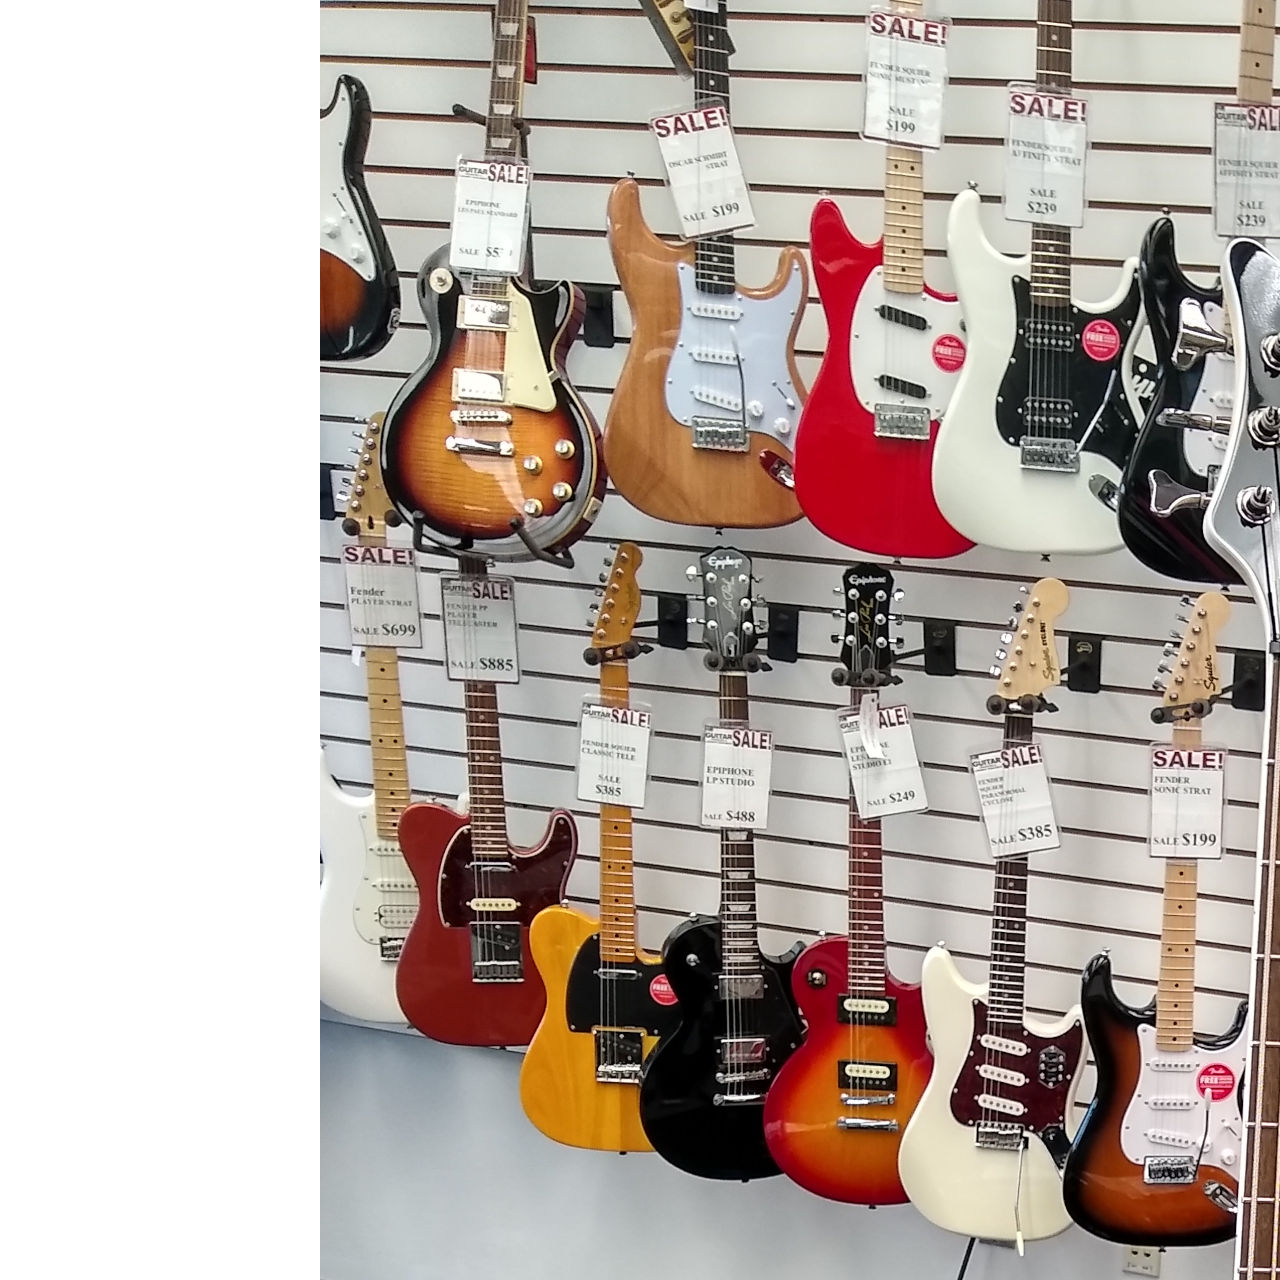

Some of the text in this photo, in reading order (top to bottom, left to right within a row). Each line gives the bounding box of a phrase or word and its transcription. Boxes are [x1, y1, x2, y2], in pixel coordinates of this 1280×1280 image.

[870, 13, 947, 45] SALE!
[888, 105, 915, 117] SALE
[1010, 93, 1086, 122] SALE!
[654, 106, 728, 138] SALE!
[886, 119, 915, 134] $199
[706, 160, 729, 170] STRAT
[488, 164, 528, 184] SALE!
[1030, 187, 1056, 199] SALE
[712, 202, 740, 217] $199
[1027, 200, 1057, 214] $239
[1238, 200, 1263, 209] SALE
[683, 211, 708, 222] SALE
[1236, 214, 1266, 227] $239
[459, 247, 480, 256] SALE
[344, 547, 414, 565] SALE!
[350, 586, 385, 597] Fender
[472, 582, 513, 601] SALE!
[354, 623, 416, 637] SALE $699
[451, 658, 514, 671] SALE $885
[1204, 654, 1219, 692] Squier
[610, 708, 650, 728] SALE!
[733, 730, 772, 750] SALE!
[1001, 745, 1042, 769] SALE!
[1153, 750, 1223, 769] SALE!
[598, 774, 621, 783] SALE
[706, 766, 754, 777] EPIPHONE
[717, 777, 755, 787] STUDIO
[1154, 776, 1190, 784] FENDER
[595, 784, 622, 797] $385
[1154, 786, 1211, 795] SONIC STRAT
[867, 790, 916, 807] SALE $249
[726, 810, 755, 823] $488
[990, 824, 1053, 846] SALE $385
[1153, 832, 1217, 847] SALE $199
[1200, 1076, 1219, 1085] FREE
